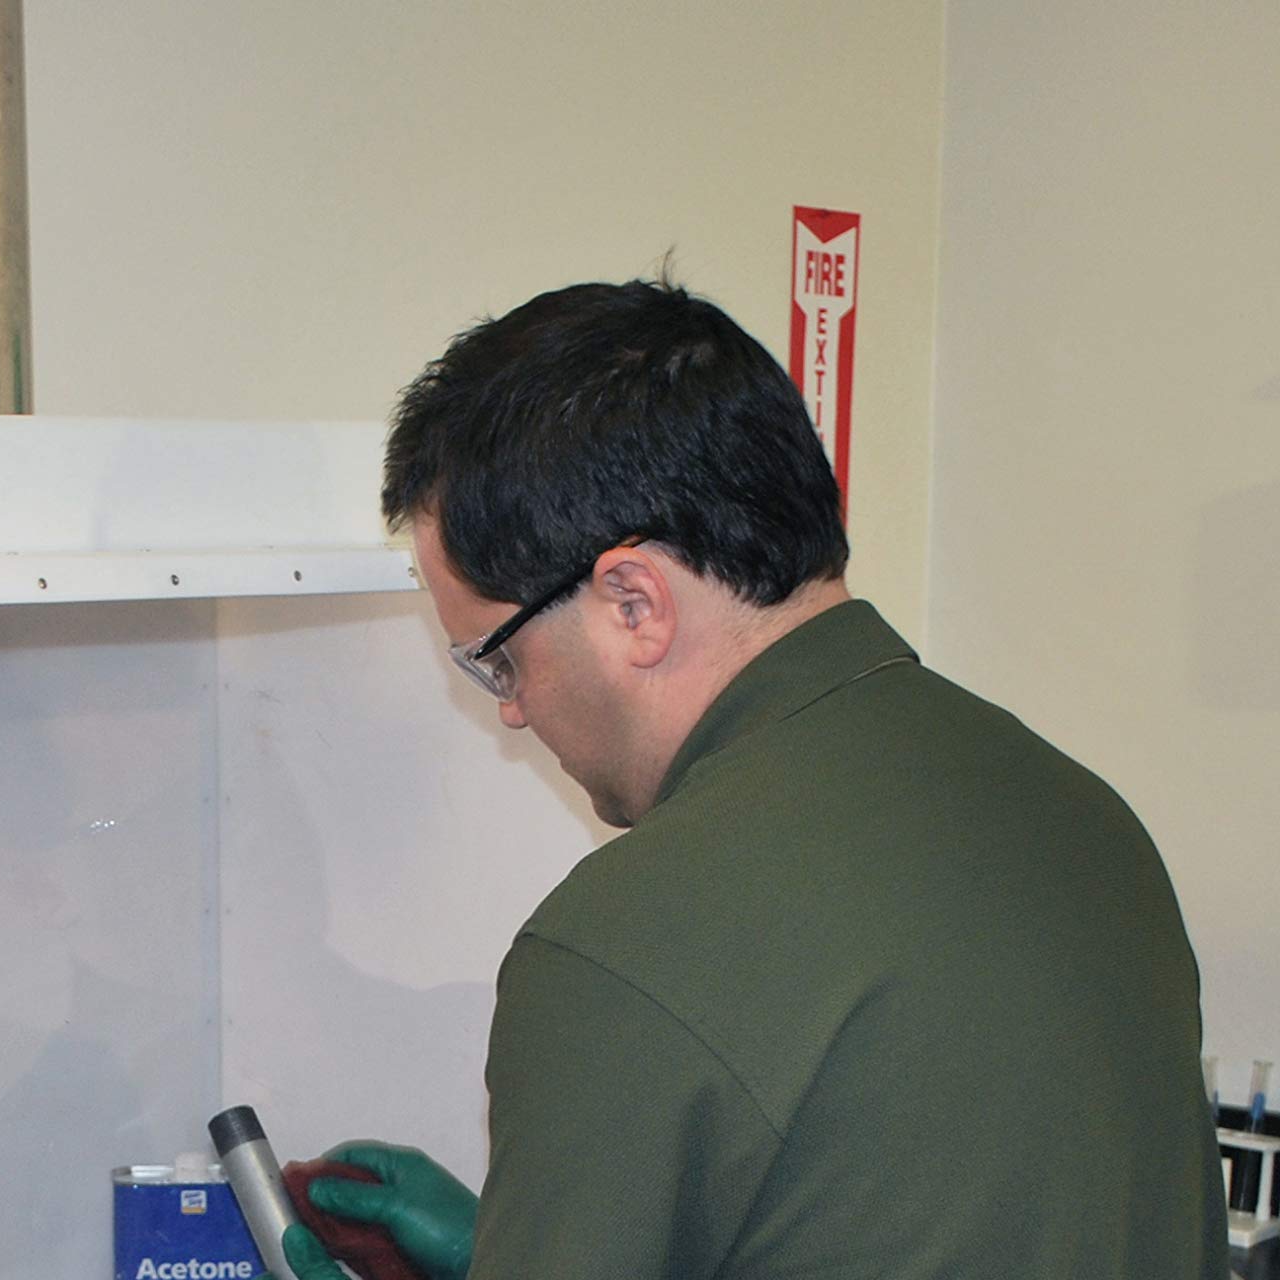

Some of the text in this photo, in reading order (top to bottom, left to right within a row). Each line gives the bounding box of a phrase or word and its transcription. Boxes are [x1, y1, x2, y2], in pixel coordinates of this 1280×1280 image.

[805, 250, 846, 297] FIRE
[815, 308, 828, 441] EXTI
[136, 1257, 252, 1280] Acetone
